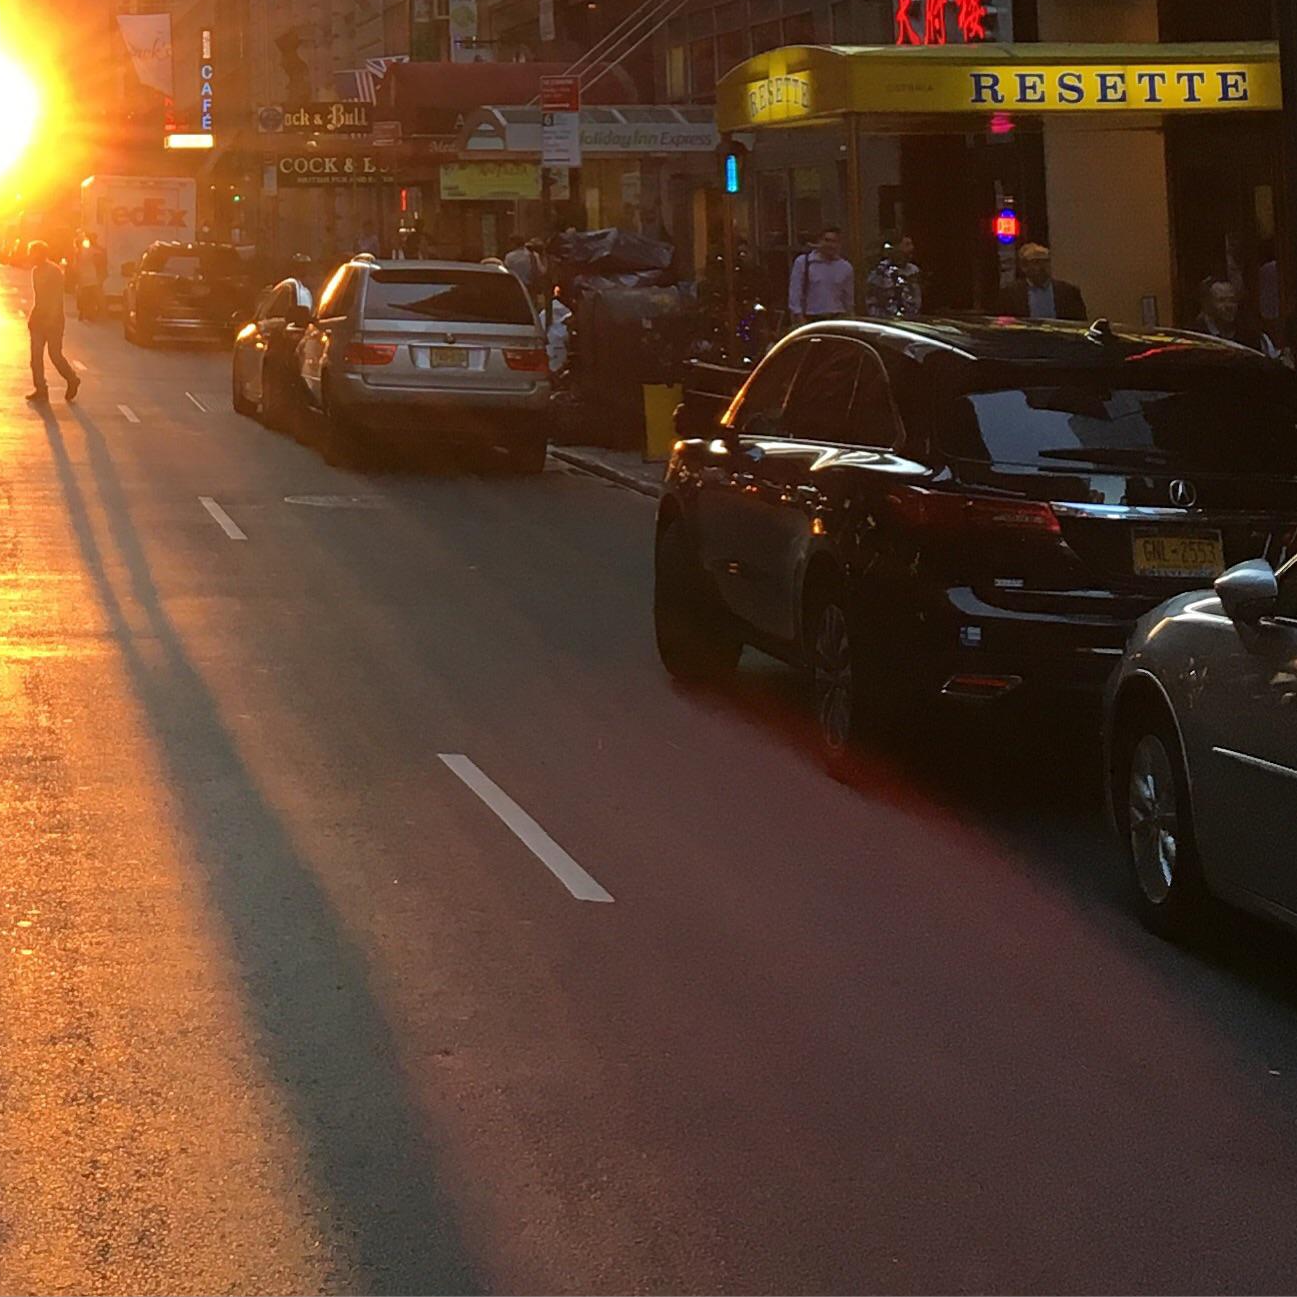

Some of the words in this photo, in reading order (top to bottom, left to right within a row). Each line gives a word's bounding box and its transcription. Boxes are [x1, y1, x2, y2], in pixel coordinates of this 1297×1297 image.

[201, 64, 213, 130] CAFÉ
[749, 76, 809, 117] RESETTE
[970, 71, 1249, 104] RESETTE
[326, 104, 369, 131] Bull
[580, 128, 630, 148] oliday
[633, 128, 658, 145] Inn
[660, 132, 712, 147] Express
[279, 157, 338, 173] COCK
[96, 196, 187, 228] FedEx
